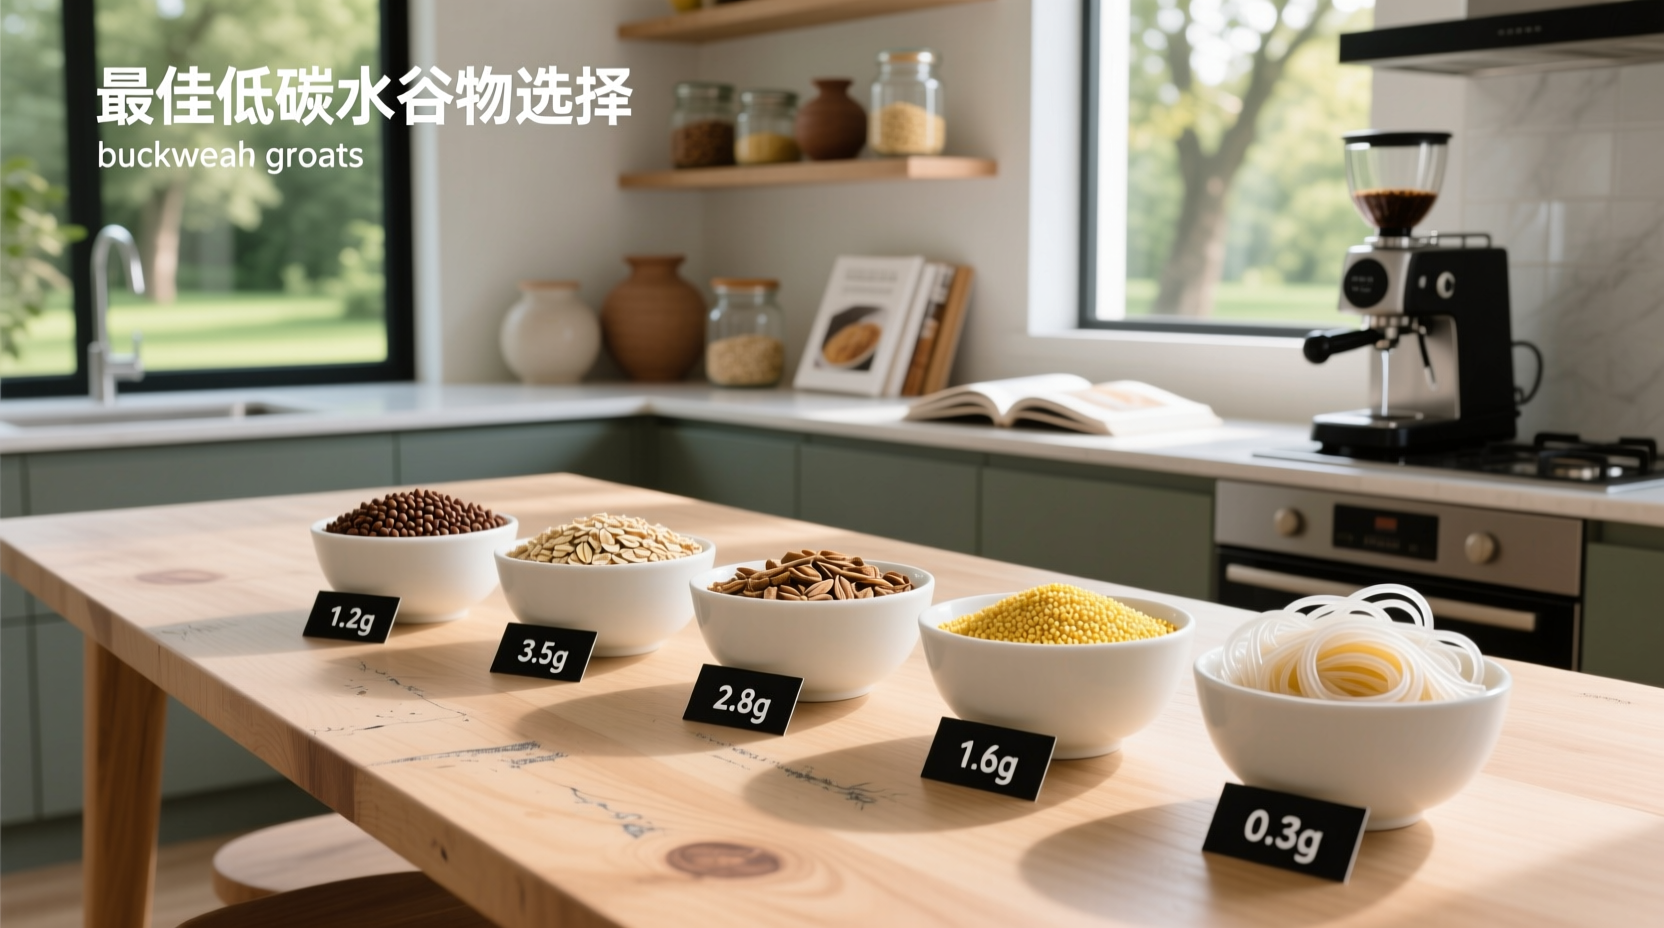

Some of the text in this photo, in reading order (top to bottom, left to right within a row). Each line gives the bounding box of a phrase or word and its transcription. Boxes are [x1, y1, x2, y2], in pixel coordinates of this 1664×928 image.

[331, 606, 375, 636] 1.2g
[517, 639, 569, 674] 3.5g
[712, 684, 772, 725] 2.8g
[959, 739, 1020, 787] 1.6g
[1243, 808, 1324, 866] 0.3g
